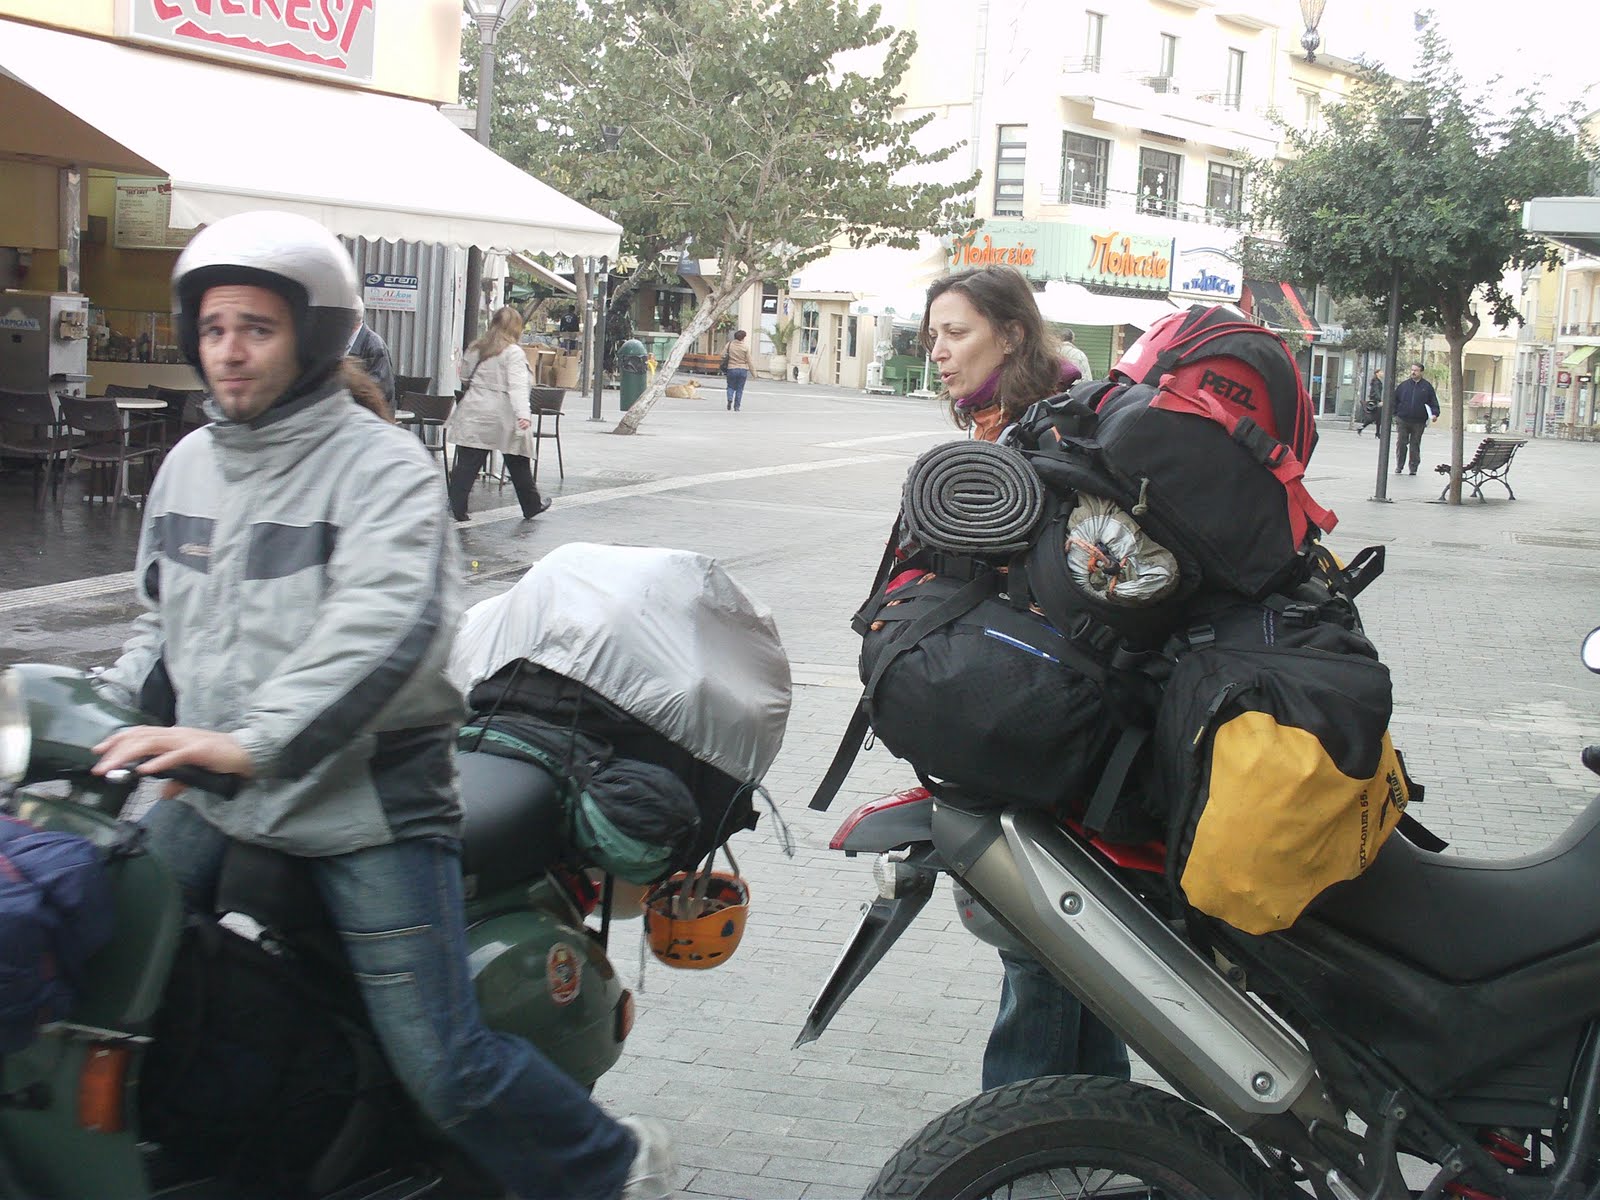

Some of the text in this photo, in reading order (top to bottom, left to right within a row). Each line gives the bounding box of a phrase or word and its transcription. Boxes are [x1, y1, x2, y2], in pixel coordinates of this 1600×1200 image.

[1089, 231, 1170, 279] Πολιτεία
[0, 318, 36, 329] ARPIGIANI
[1322, 328, 1343, 341] LPHA
[1198, 369, 1257, 411] PETZL
[1359, 809, 1369, 869] EXPLORER
